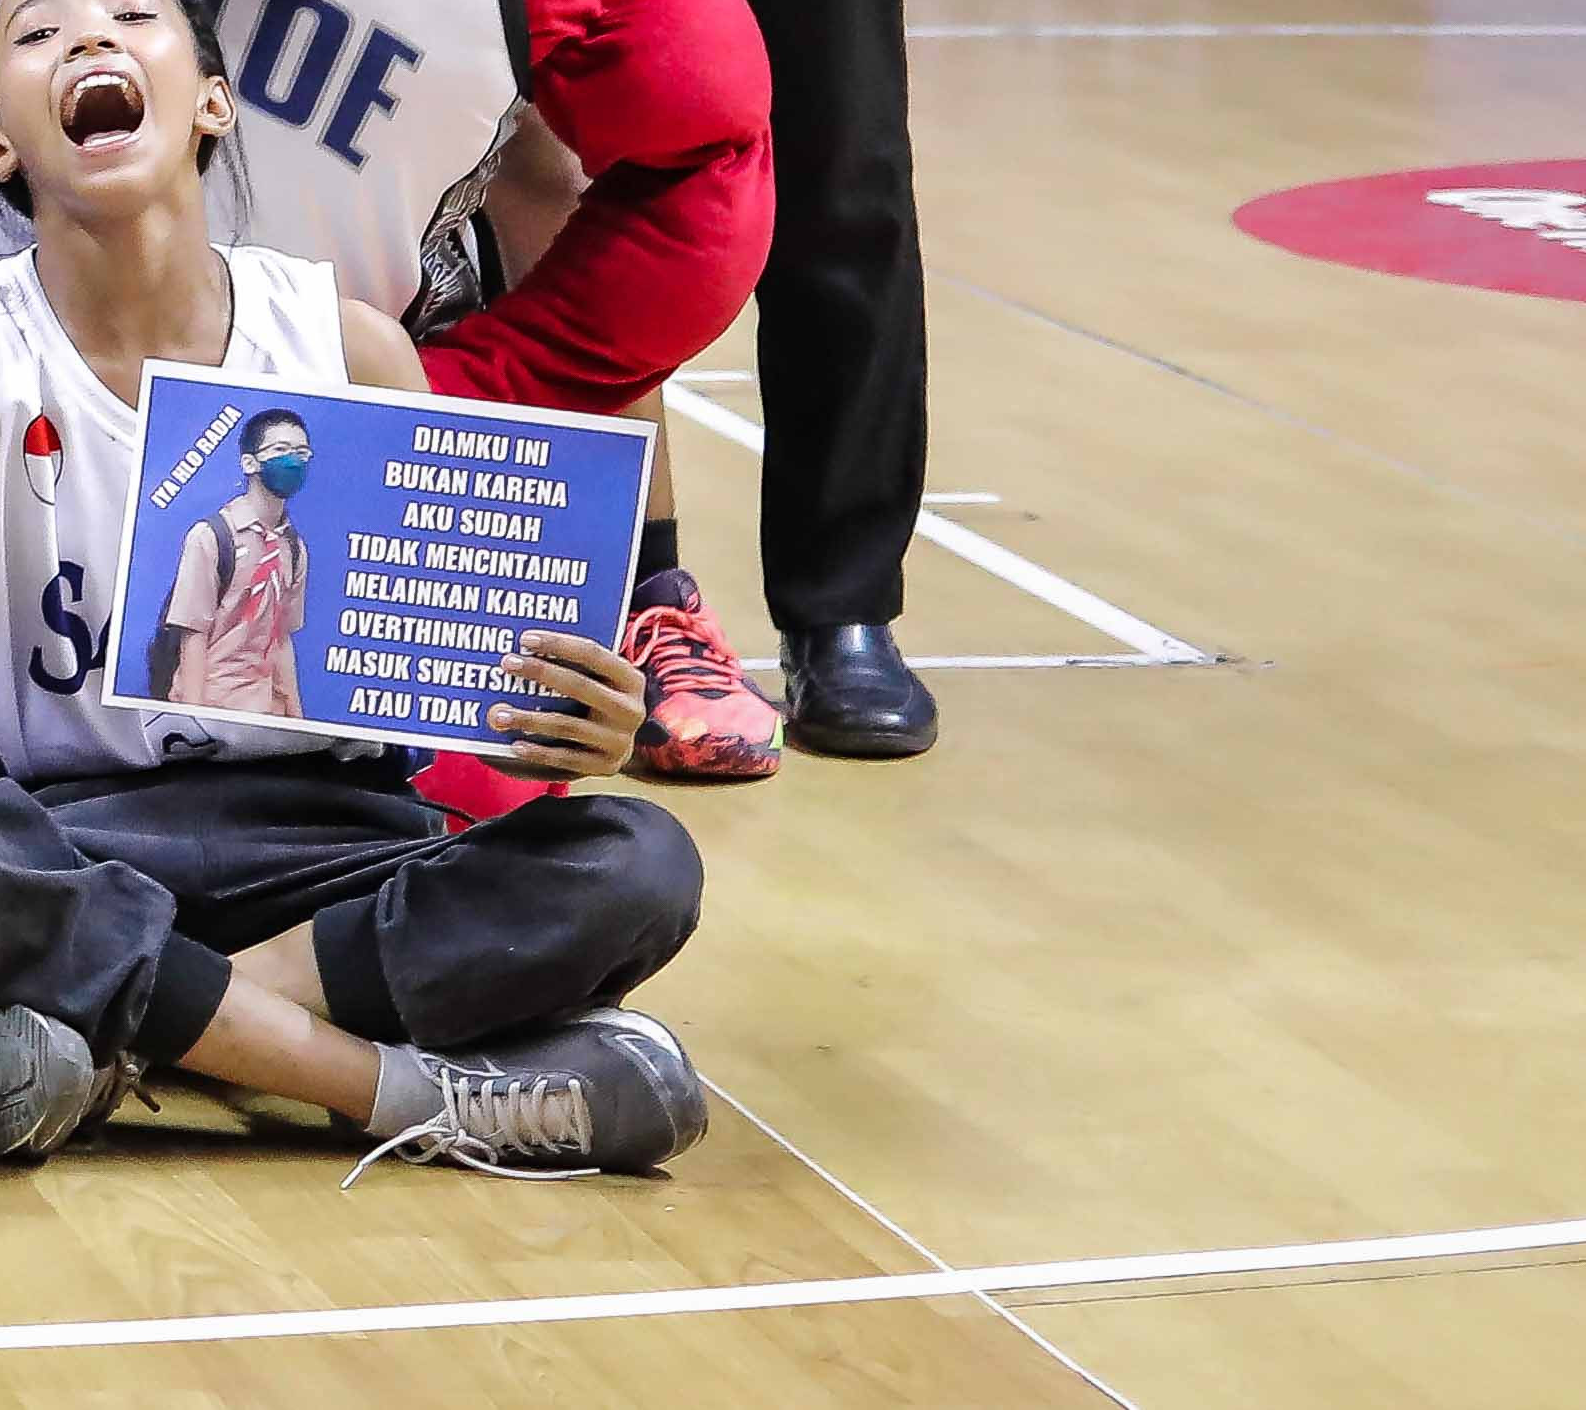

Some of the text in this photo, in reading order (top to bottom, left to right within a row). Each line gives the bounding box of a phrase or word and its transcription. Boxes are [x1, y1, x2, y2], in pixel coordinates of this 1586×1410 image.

[193, 403, 245, 458] RADJA
[412, 424, 550, 468] DIAMKU INI
[384, 460, 569, 509] BUKAN KARENA
[402, 500, 542, 543] AKU SUDAH
[346, 531, 589, 588] TIDAK MENCINTAIMU
[345, 569, 580, 625] MELAINKAN KARENA
[339, 609, 515, 655] OVERTHINKING
[325, 647, 412, 682] MASUK
[349, 687, 481, 728] ATAU TDAK
